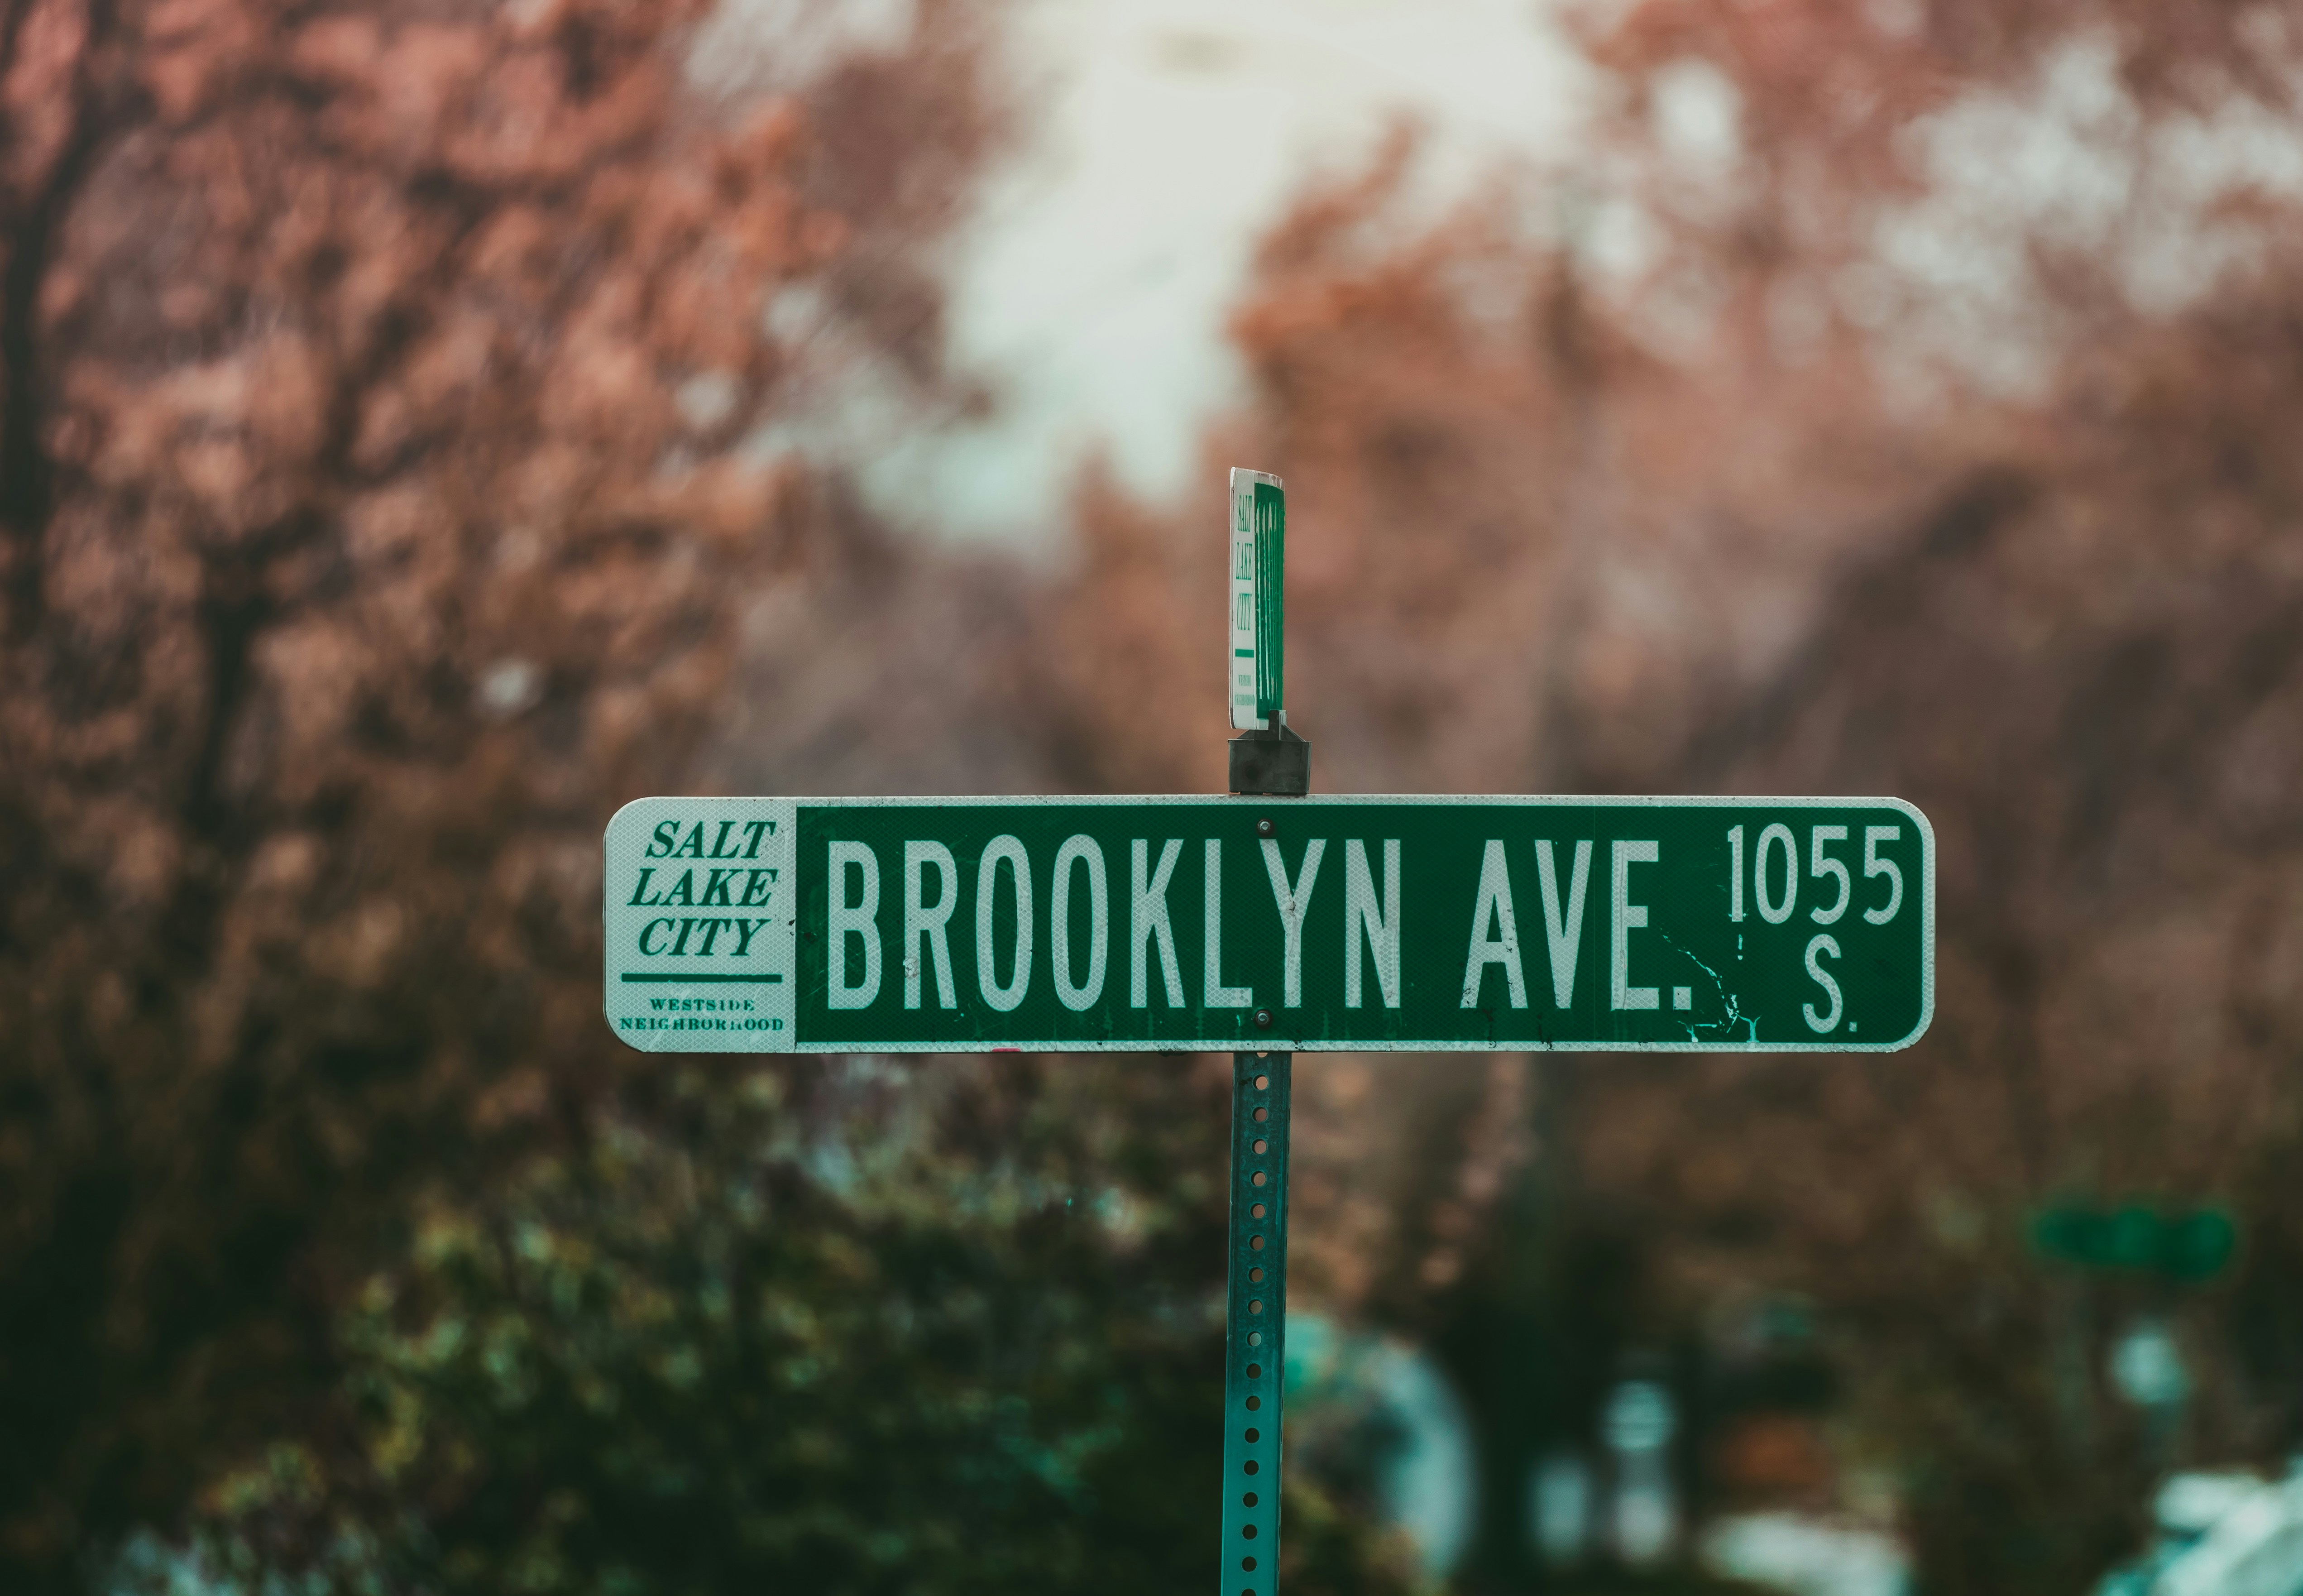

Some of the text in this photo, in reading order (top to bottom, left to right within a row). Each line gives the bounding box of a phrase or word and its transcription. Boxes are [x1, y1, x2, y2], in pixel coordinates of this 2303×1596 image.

[1237, 494, 1252, 532] SALT
[1235, 542, 1253, 580] LAKE
[1237, 592, 1252, 631] CITY
[645, 820, 777, 859] SALT
[627, 868, 779, 907] LAKE
[1727, 822, 1903, 925] 1055
[638, 917, 771, 957] CITY
[828, 834, 1692, 1012] BROOKLYN AVE.
[1802, 933, 1858, 1034] S.
[650, 998, 755, 1011] WESTSIDE
